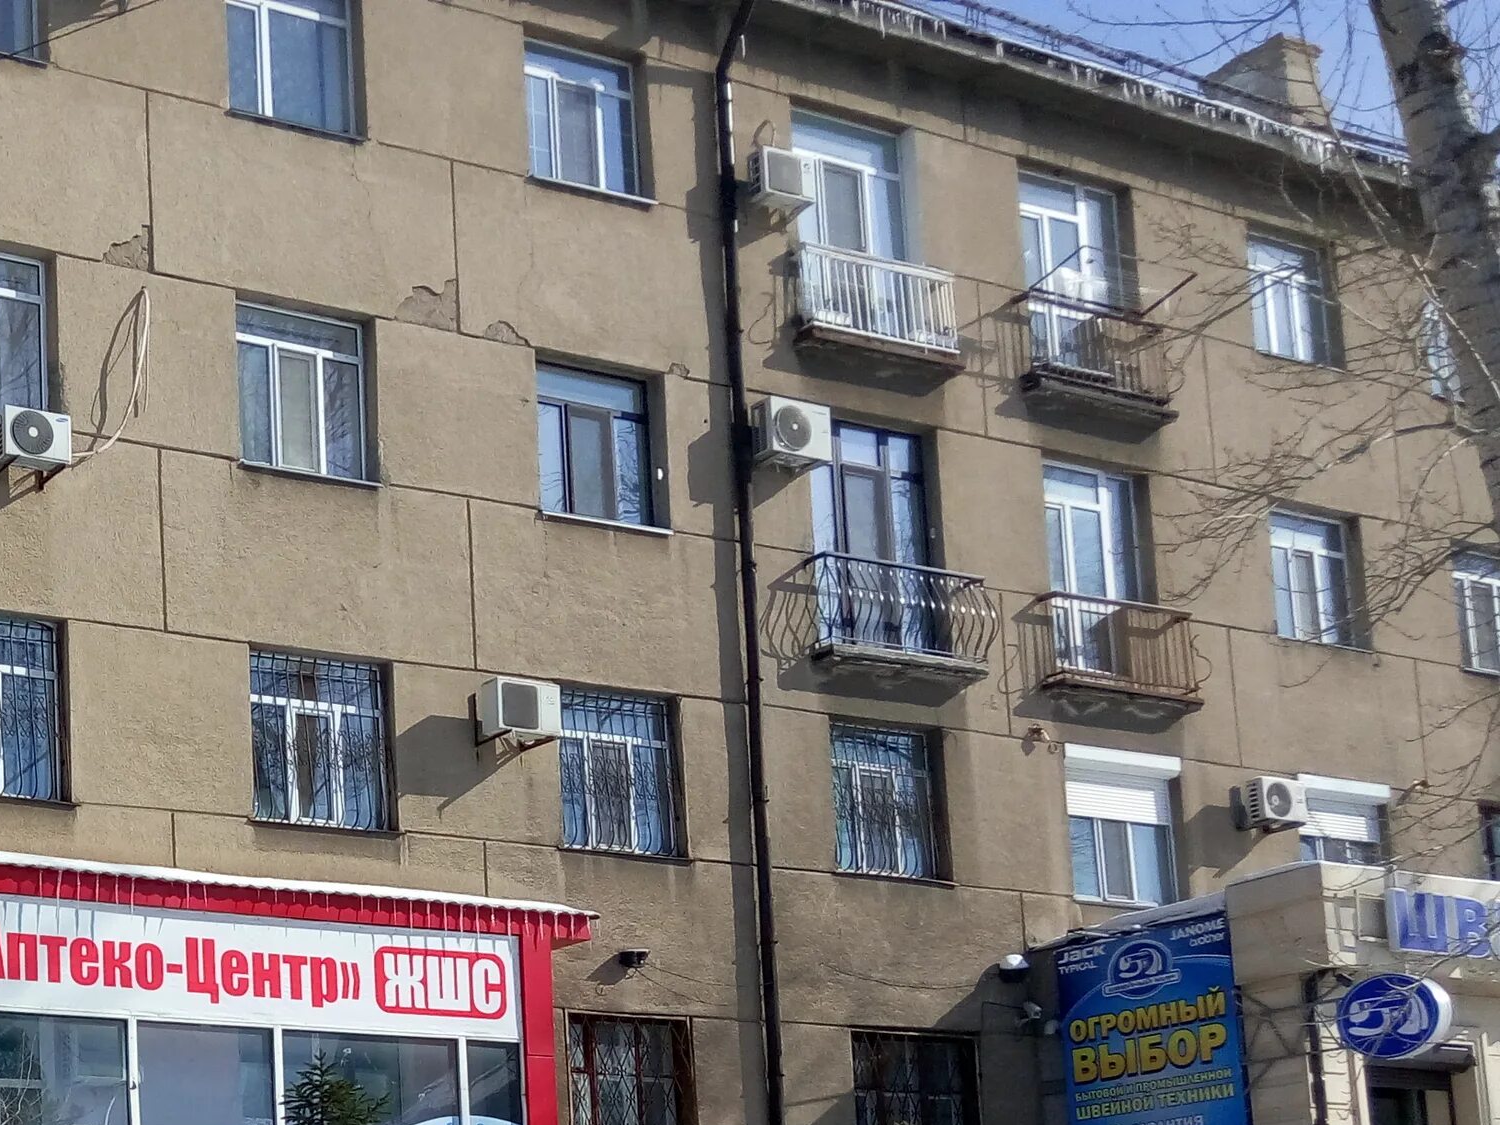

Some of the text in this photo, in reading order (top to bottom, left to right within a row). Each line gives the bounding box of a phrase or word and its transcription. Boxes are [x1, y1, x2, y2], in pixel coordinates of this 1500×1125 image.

[1170, 917, 1225, 940] JANOME
[1387, 887, 1500, 959] ШВ
[382, 952, 502, 1015] ЖШС
[1069, 986, 1226, 1043] ОГРОМНЫЙ
[1072, 1023, 1228, 1084] ВЫБОР
[1075, 1084, 1124, 1102] БЫТОВОЙ
[1076, 1083, 1234, 1121] ШВЕЙНОЙ ТЕХНИКИ
